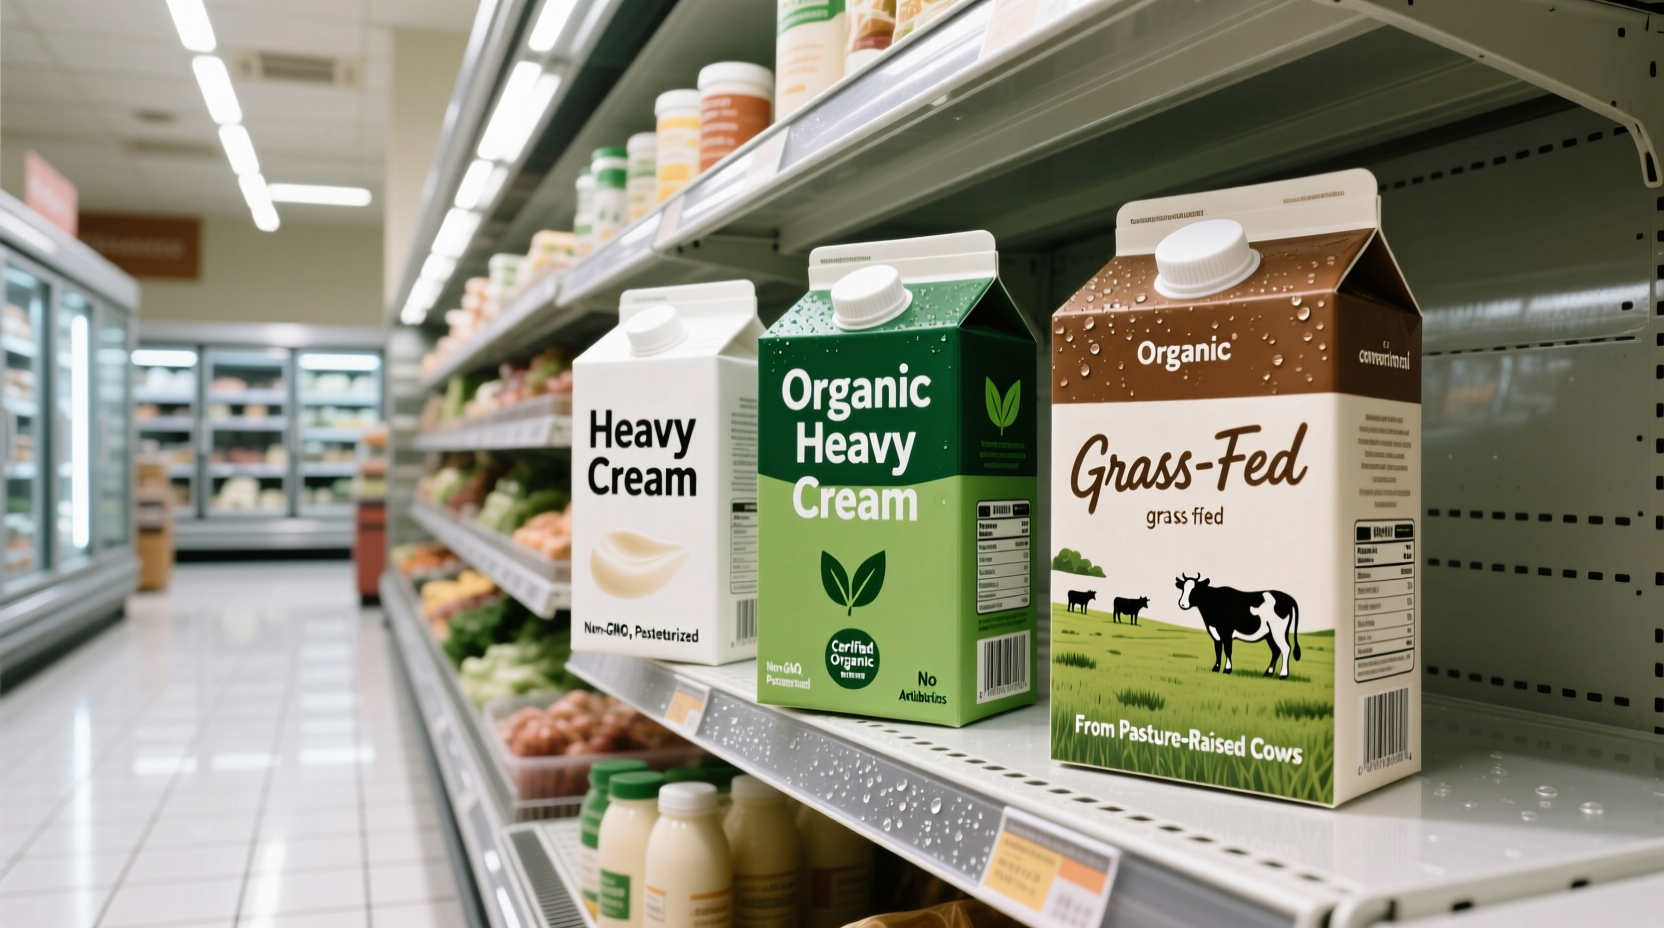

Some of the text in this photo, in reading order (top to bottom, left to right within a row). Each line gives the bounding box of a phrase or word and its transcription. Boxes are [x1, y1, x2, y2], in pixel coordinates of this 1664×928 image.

[1137, 336, 1232, 372] Organic
[781, 363, 932, 422] Organic
[589, 409, 697, 459] Heavy
[796, 421, 917, 477] Heavy
[587, 456, 698, 497] Cream
[1070, 422, 1309, 515] Grass-Fed
[792, 475, 918, 522] Cream
[1146, 510, 1188, 530] grass
[830, 653, 875, 671] Organic
[917, 670, 938, 687] No
[1075, 713, 1303, 765] From Pasture-Raised Cows
